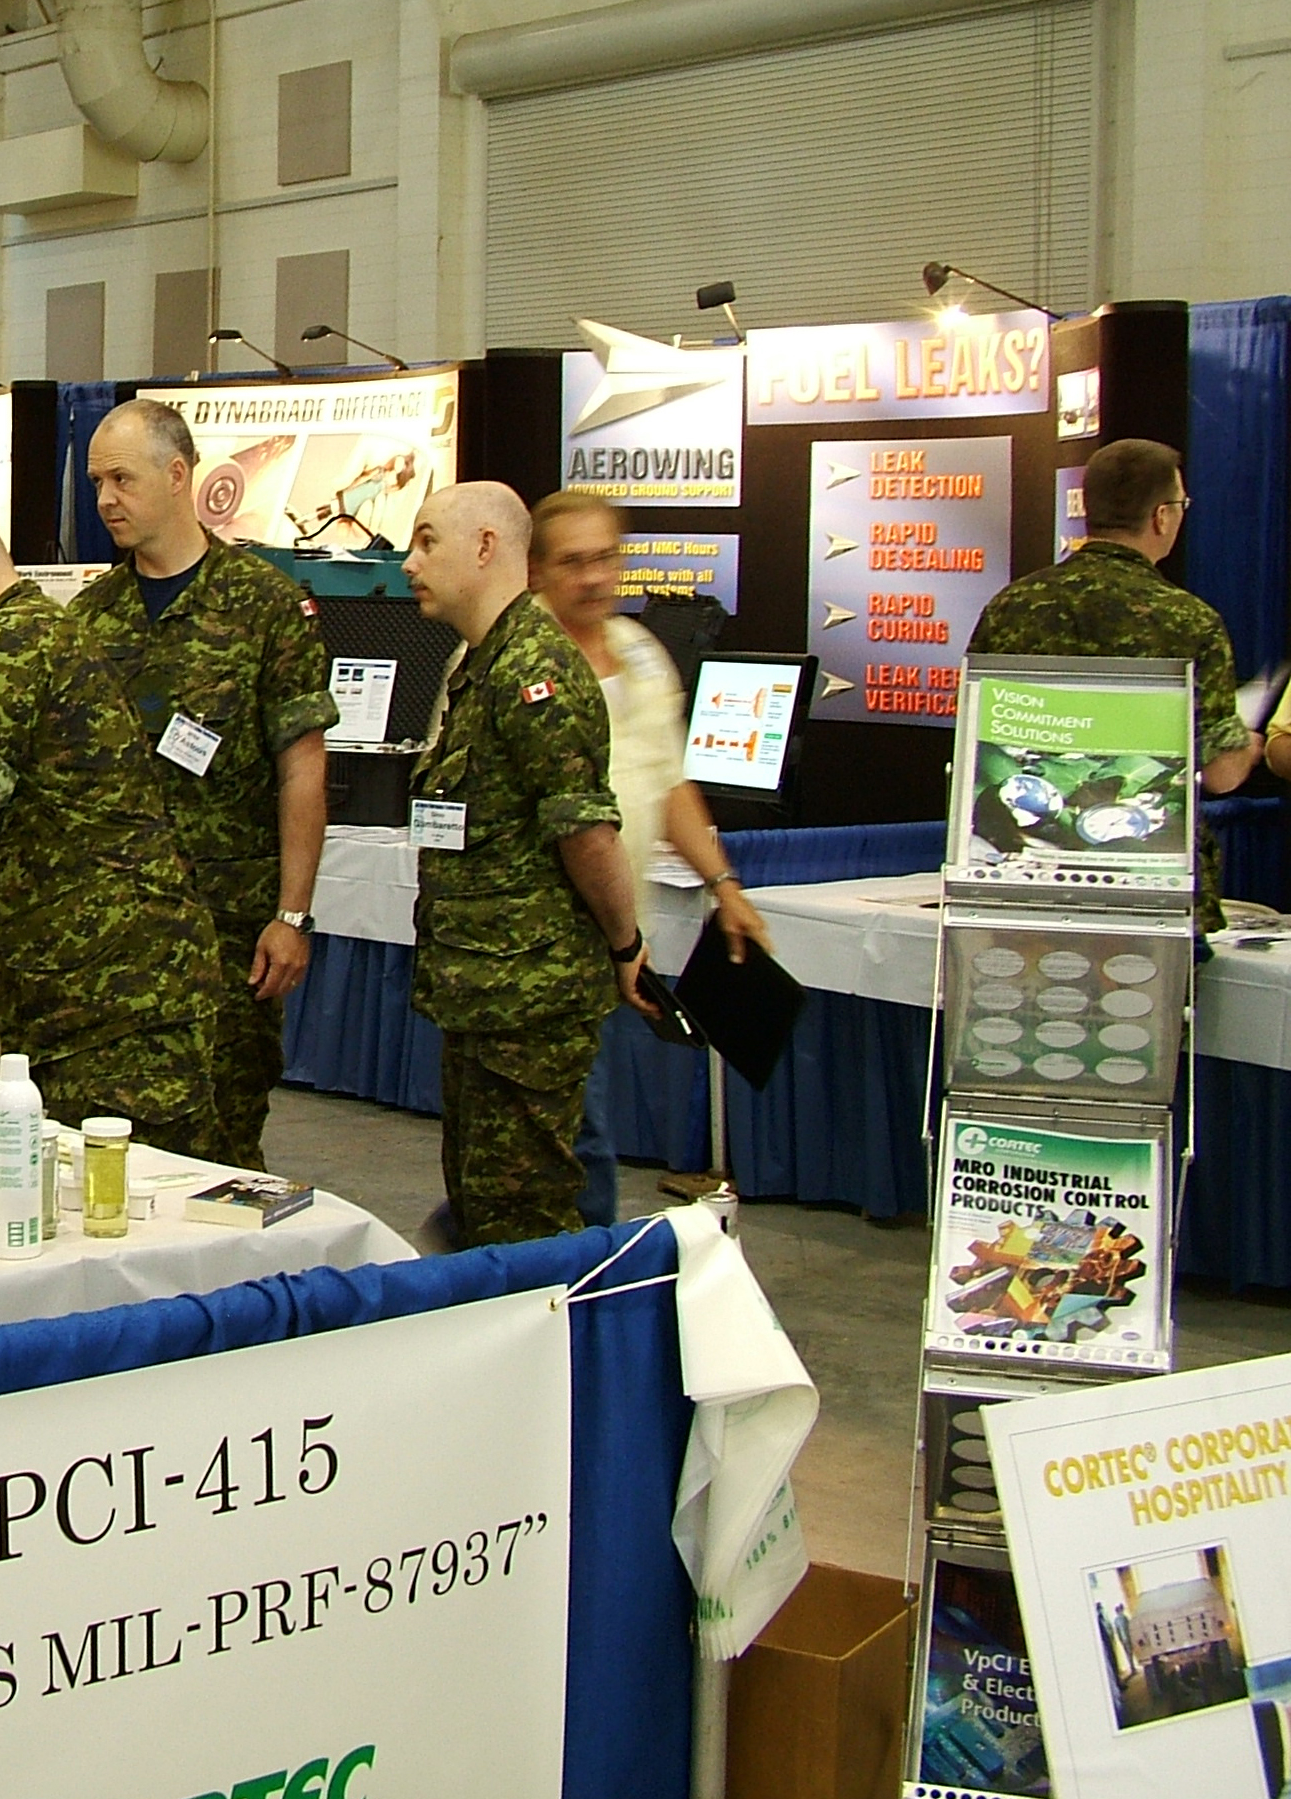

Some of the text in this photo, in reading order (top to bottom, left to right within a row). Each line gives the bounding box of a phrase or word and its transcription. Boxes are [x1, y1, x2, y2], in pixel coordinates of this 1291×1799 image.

[757, 327, 1045, 405] FUEL LEAKS?
[194, 399, 326, 424] DYNABRADE
[332, 391, 423, 421] DIFFERENCE
[567, 447, 734, 480] AEROWING
[869, 450, 925, 474] LEAK
[567, 483, 735, 498] ADVANCED GROUND SUPPORT
[869, 475, 983, 500] DETECTION
[869, 521, 937, 546] RAPID
[619, 541, 720, 556] uced NMC Hours
[868, 547, 985, 573] DESEALING
[619, 567, 713, 583] patible with all
[613, 584, 643, 597] apon
[867, 593, 936, 618] RAPID
[867, 619, 950, 644] CURING
[865, 663, 921, 689] LEAK
[865, 689, 957, 718] VERIFICA
[991, 687, 1045, 708] VISION
[991, 703, 1095, 729] COMMITMENT
[990, 719, 1074, 745] SOLUTIONS
[988, 1137, 1043, 1154] CORTEC
[953, 1158, 1112, 1191] MRO INDUSTRIAL
[952, 1175, 1150, 1210] CORROSION CONTROL
[950, 1192, 1046, 1221] PRODUCTS
[1127, 1460, 1288, 1527] HOSPITALITY
[963, 1648, 1013, 1673] VpCI
[962, 1673, 1035, 1702] & Elect
